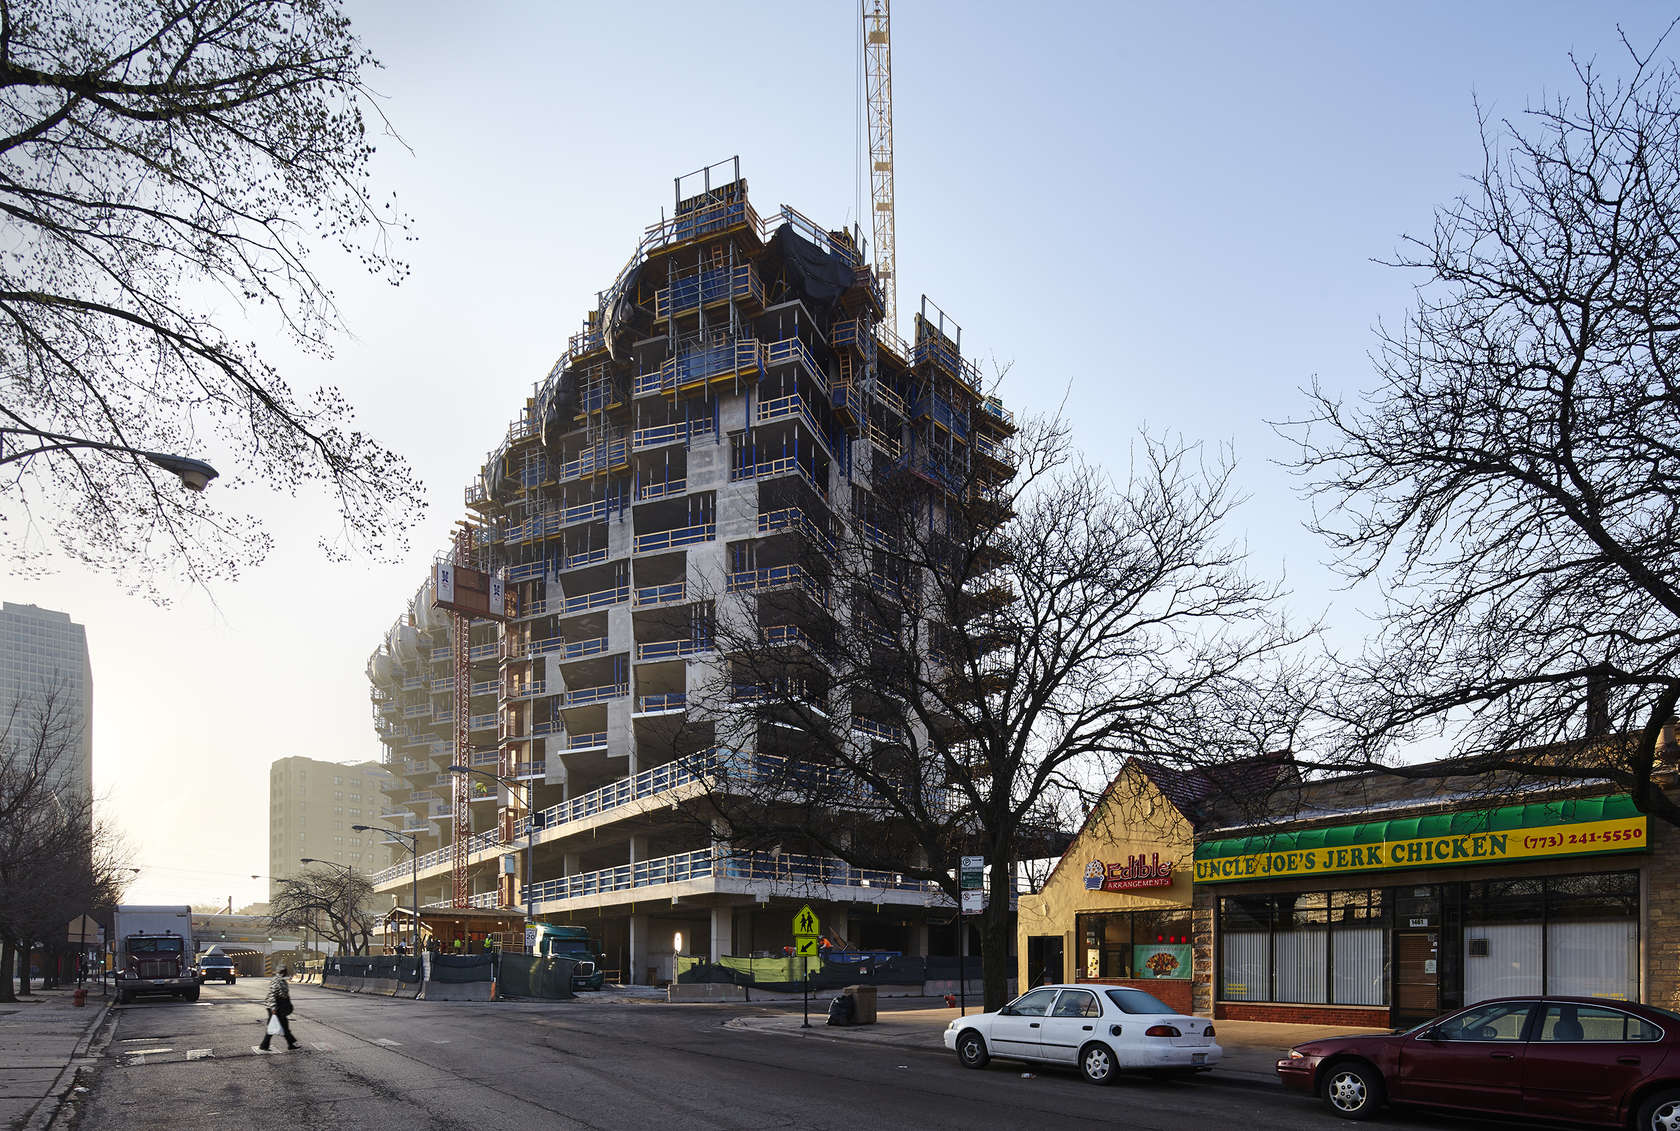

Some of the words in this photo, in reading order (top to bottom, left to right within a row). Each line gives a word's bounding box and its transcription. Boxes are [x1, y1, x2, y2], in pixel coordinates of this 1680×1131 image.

[1107, 852, 1173, 880] Edible
[1196, 857, 1256, 879] UNCLE
[1262, 851, 1316, 873] JOE'S
[1323, 845, 1382, 868] JERK
[1391, 834, 1508, 863] CHICKEN
[1524, 832, 1564, 849] (773)
[1568, 828, 1642, 845] 241-5550
[1108, 879, 1169, 889] ARRANGEMENTS
